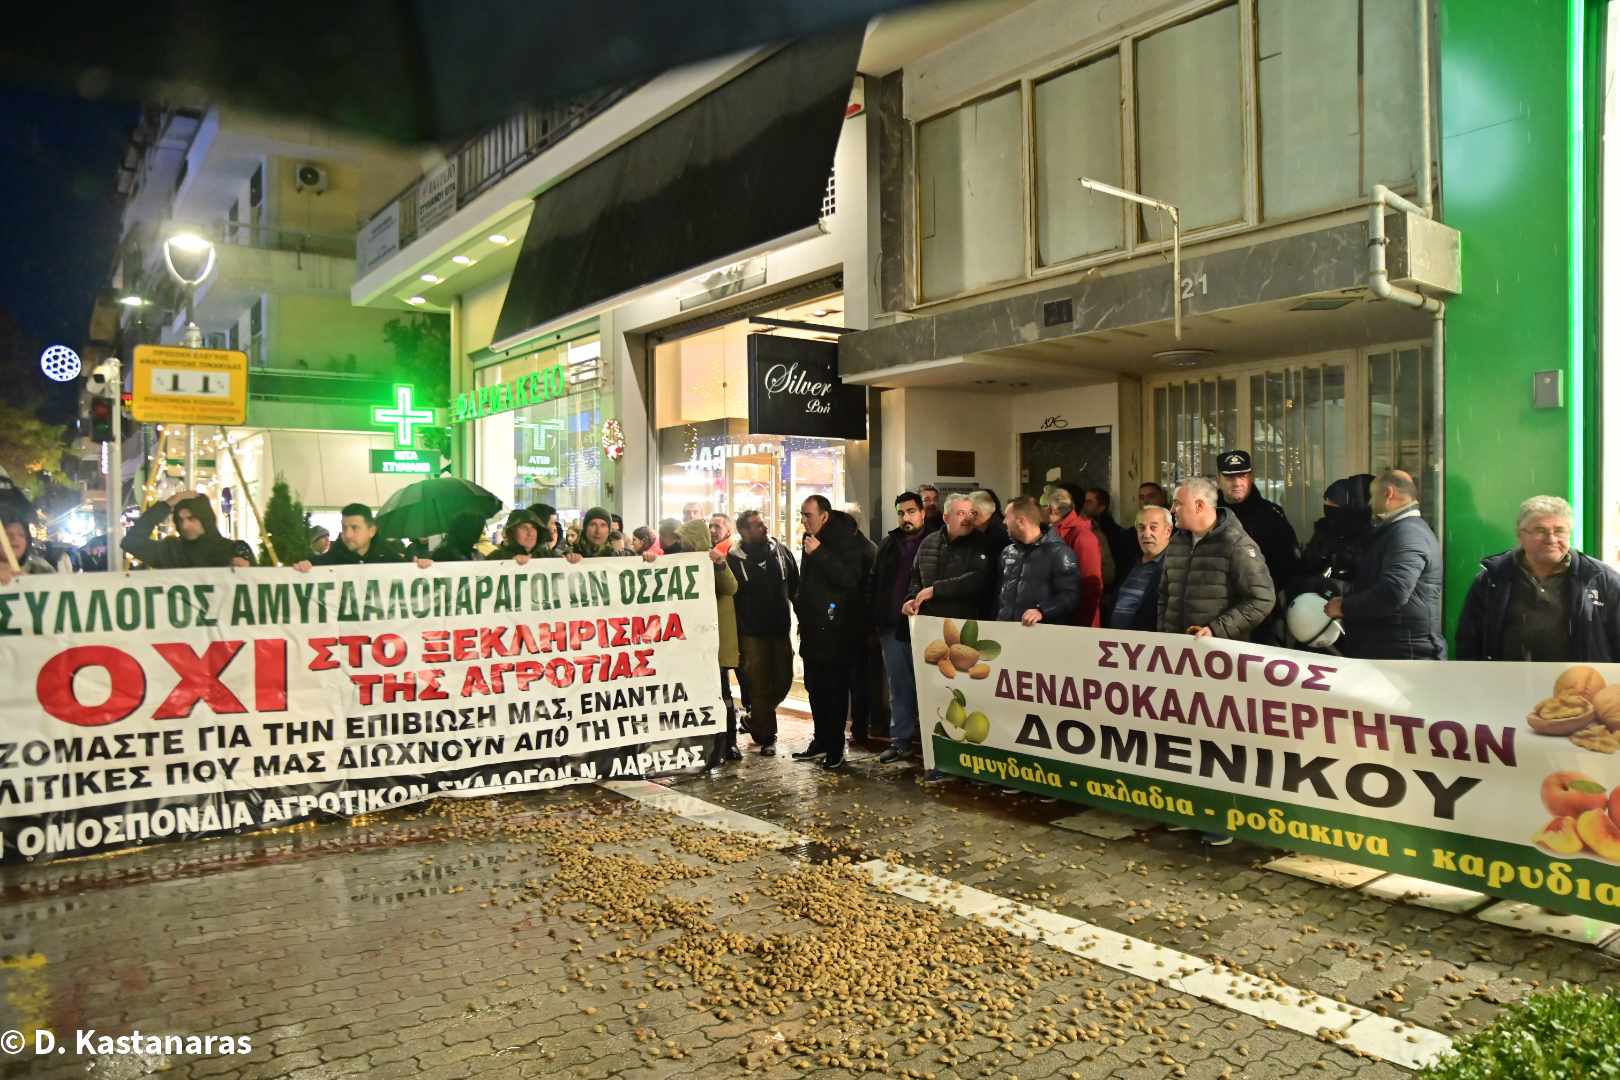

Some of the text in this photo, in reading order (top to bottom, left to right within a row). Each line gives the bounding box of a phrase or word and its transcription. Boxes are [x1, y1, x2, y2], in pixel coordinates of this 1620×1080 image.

[1181, 273, 1208, 300] 21
[455, 364, 565, 420] ΦΑΡΜΑΚΕΙΟ
[765, 362, 832, 399] Silver
[0, 565, 699, 635] ΣΥΛΛΟΓΟΣ ΑΜΥΓΔΑΛΟΠΑΡΑΓΩΓΩΝ ΟΣΣΑΣ
[308, 613, 687, 671] ΣΤΟ ΞΕΚΛΗΡΙΣΜΑ
[351, 649, 656, 705] ΤΗΣ ΑΓΡΟΤΙΑΣ
[1098, 640, 1338, 691] ΣΥΛΛΟΓΟΣ
[36, 639, 288, 726] ΟΧΙ
[994, 668, 1517, 767] ΔΕΝΔΡΟΚΑΛΛΙΕΡΓΗΤΩΝ
[0, 683, 689, 768] ΖΟΜΑΣΤΕ ΓΙΑ ΤΗΝ ΕΠΙΒΙΩΣΗ ΜΑΣ, ΕΝΑΝΤΙΑ
[166, 757, 240, 786] ΠΟΥ
[254, 751, 326, 778] ΜΑΣ
[338, 735, 505, 770] ΔΙΩΧΝΟΥΝ
[514, 726, 569, 752] ΑΠΟ
[577, 718, 610, 743] ΤΗ
[617, 713, 649, 737] ΓΗ
[658, 706, 716, 731] ΜΑΣ
[17, 802, 253, 857] ΟΜΟΣΠΟΝΔΙΑ
[610, 745, 706, 777] ΛΑΡΙΣΑΣ
[1014, 713, 1483, 821] ΔΟΜΕΝΙΚΟΥ
[959, 752, 1063, 788] αμυγδαλα
[1086, 779, 1195, 816] αχλαδια
[1227, 807, 1390, 857] ροδακινα
[1432, 848, 1620, 908] καρυδια
